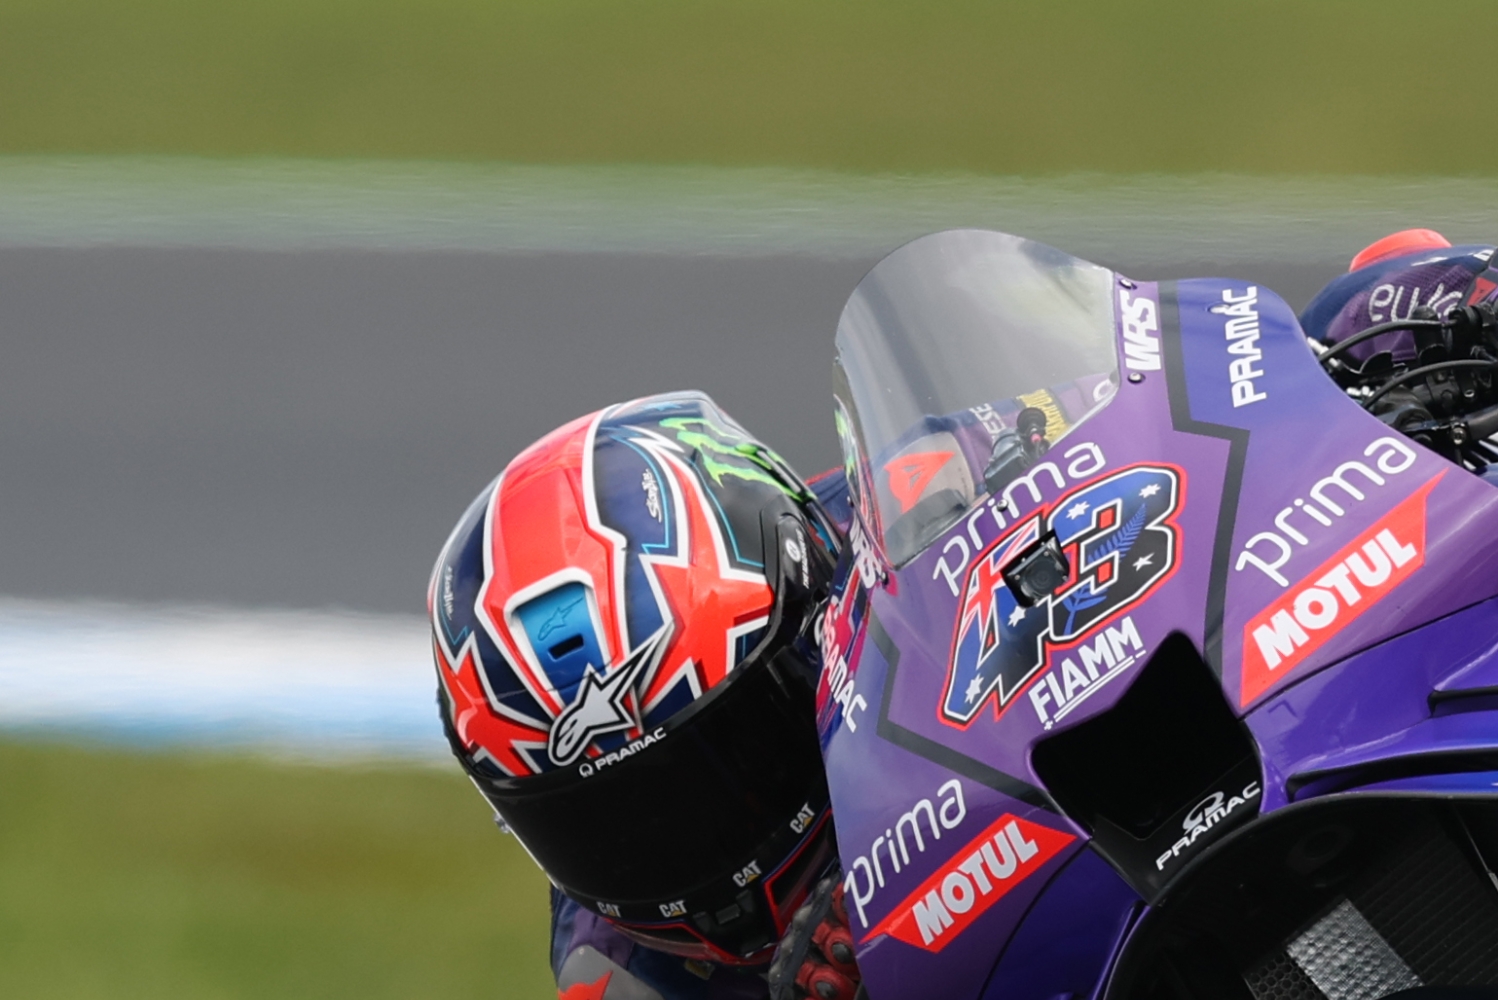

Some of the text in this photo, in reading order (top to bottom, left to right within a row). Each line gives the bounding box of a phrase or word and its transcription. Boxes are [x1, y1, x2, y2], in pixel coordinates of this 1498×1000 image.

[1117, 289, 1163, 371] WRS
[1222, 286, 1267, 408] PRAMAC
[933, 442, 1106, 596] prima
[1235, 435, 1417, 587] prima
[938, 462, 1187, 731] 43
[1251, 527, 1418, 671] MOTUL
[1028, 616, 1145, 725] FIAMM
[594, 727, 667, 771] PRAMAC
[789, 802, 816, 834] CAT
[843, 779, 968, 928] prima
[1156, 781, 1260, 871] PRAMAC
[596, 901, 622, 918] CAT
[658, 900, 687, 918] CAT
[732, 859, 763, 888] CAT
[911, 819, 1039, 946] MOTUL
